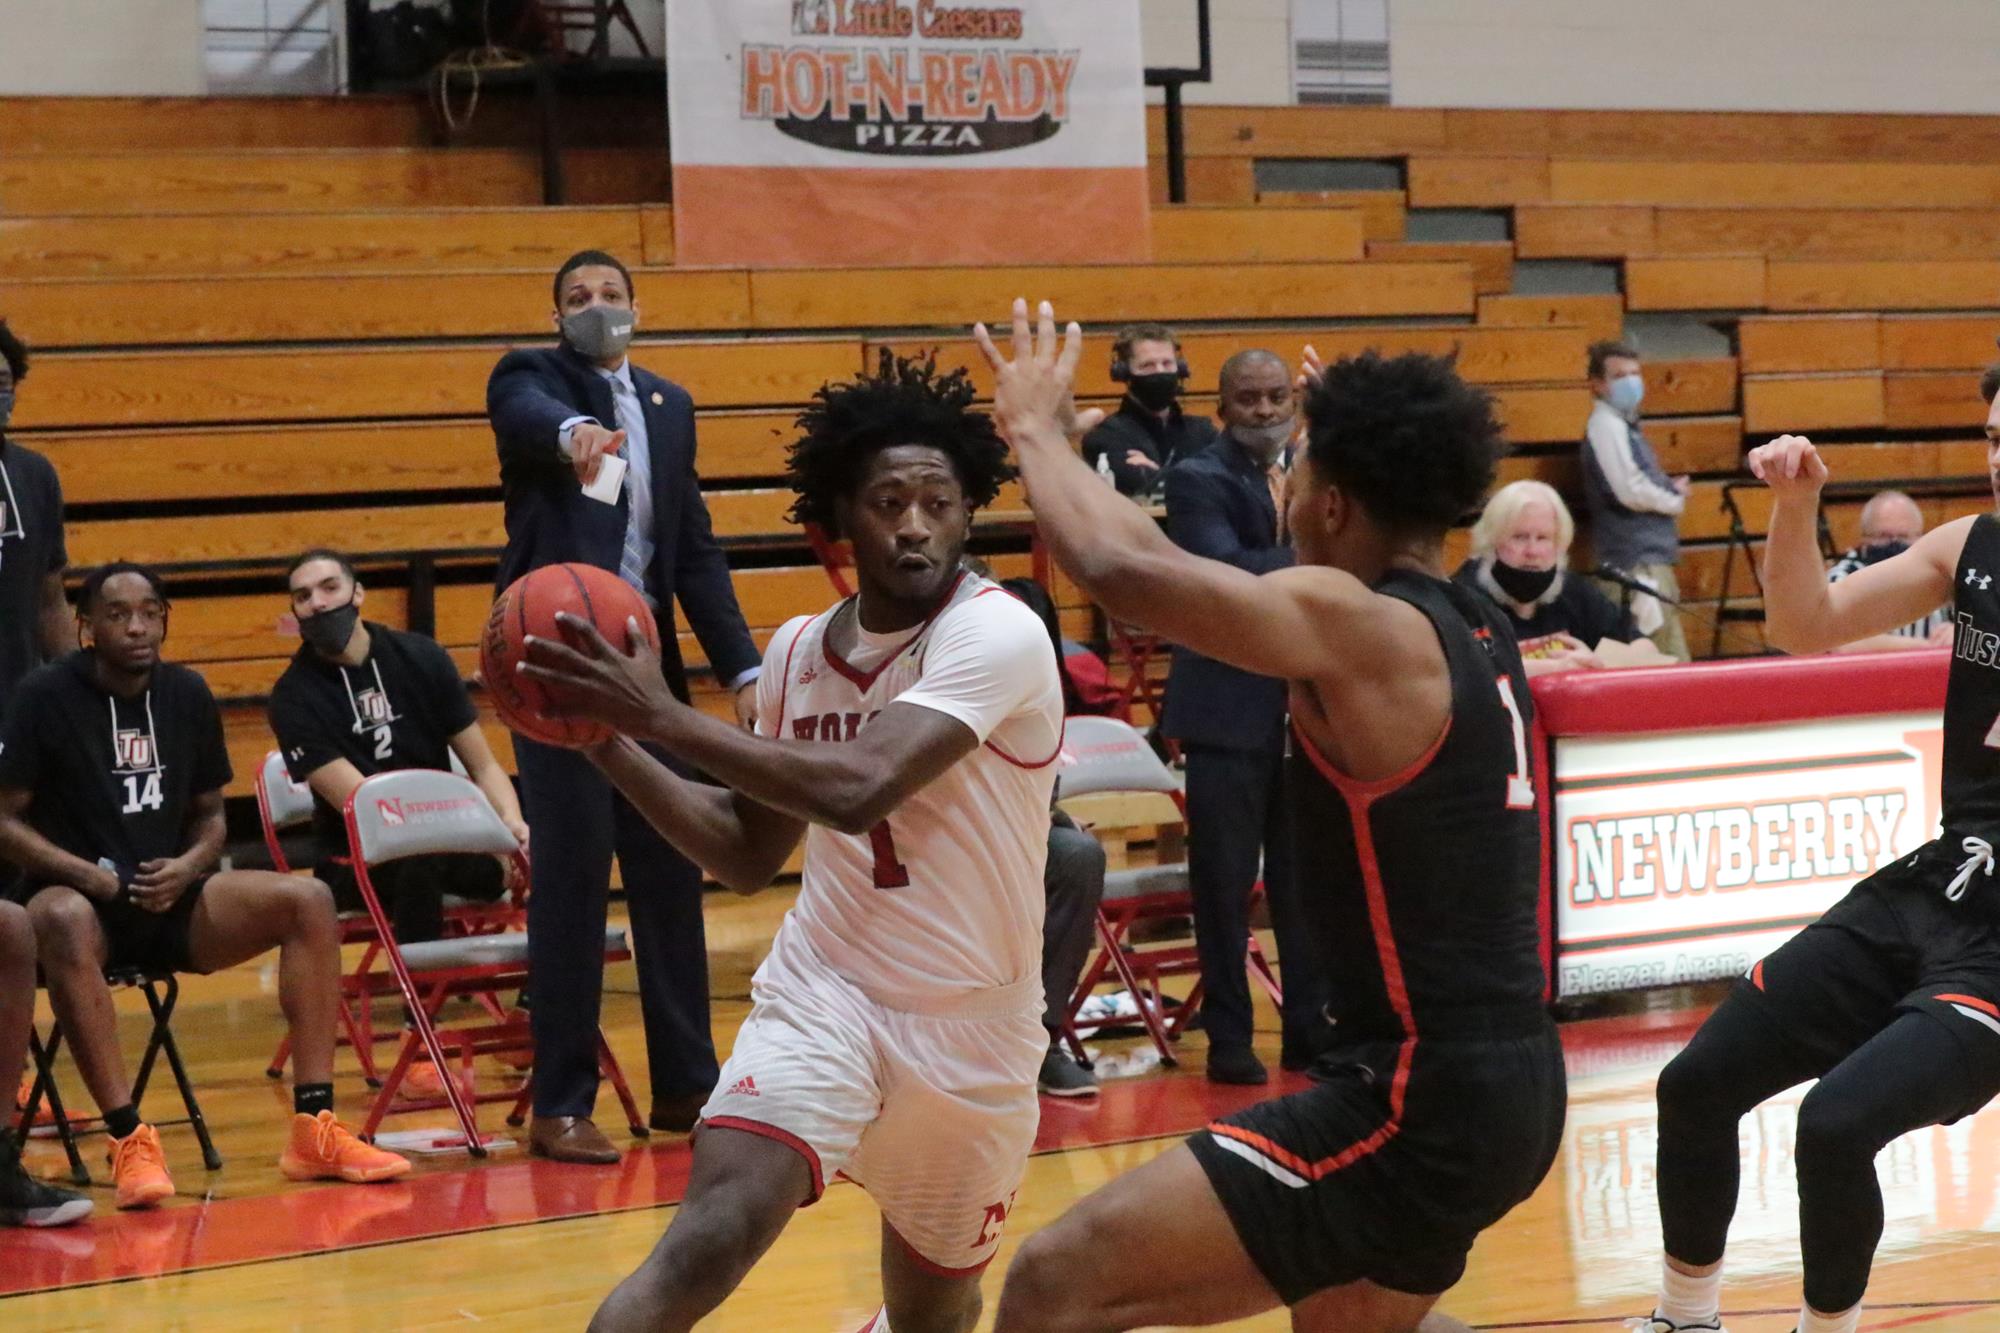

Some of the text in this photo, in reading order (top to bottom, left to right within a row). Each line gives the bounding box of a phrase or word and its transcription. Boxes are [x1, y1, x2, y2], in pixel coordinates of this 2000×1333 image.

[833, 0, 1023, 39] Little Caesars
[740, 43, 1080, 121] HOT-N-READY
[856, 124, 981, 146] PIZZA
[1956, 610, 2000, 670] TUS
[373, 724, 393, 760] 2
[792, 711, 882, 742] WOL
[1496, 673, 1536, 811] 1
[122, 773, 164, 814] 14
[1570, 791, 1906, 907] NEWBERRY
[1563, 952, 1749, 996] Eleazer Arena
